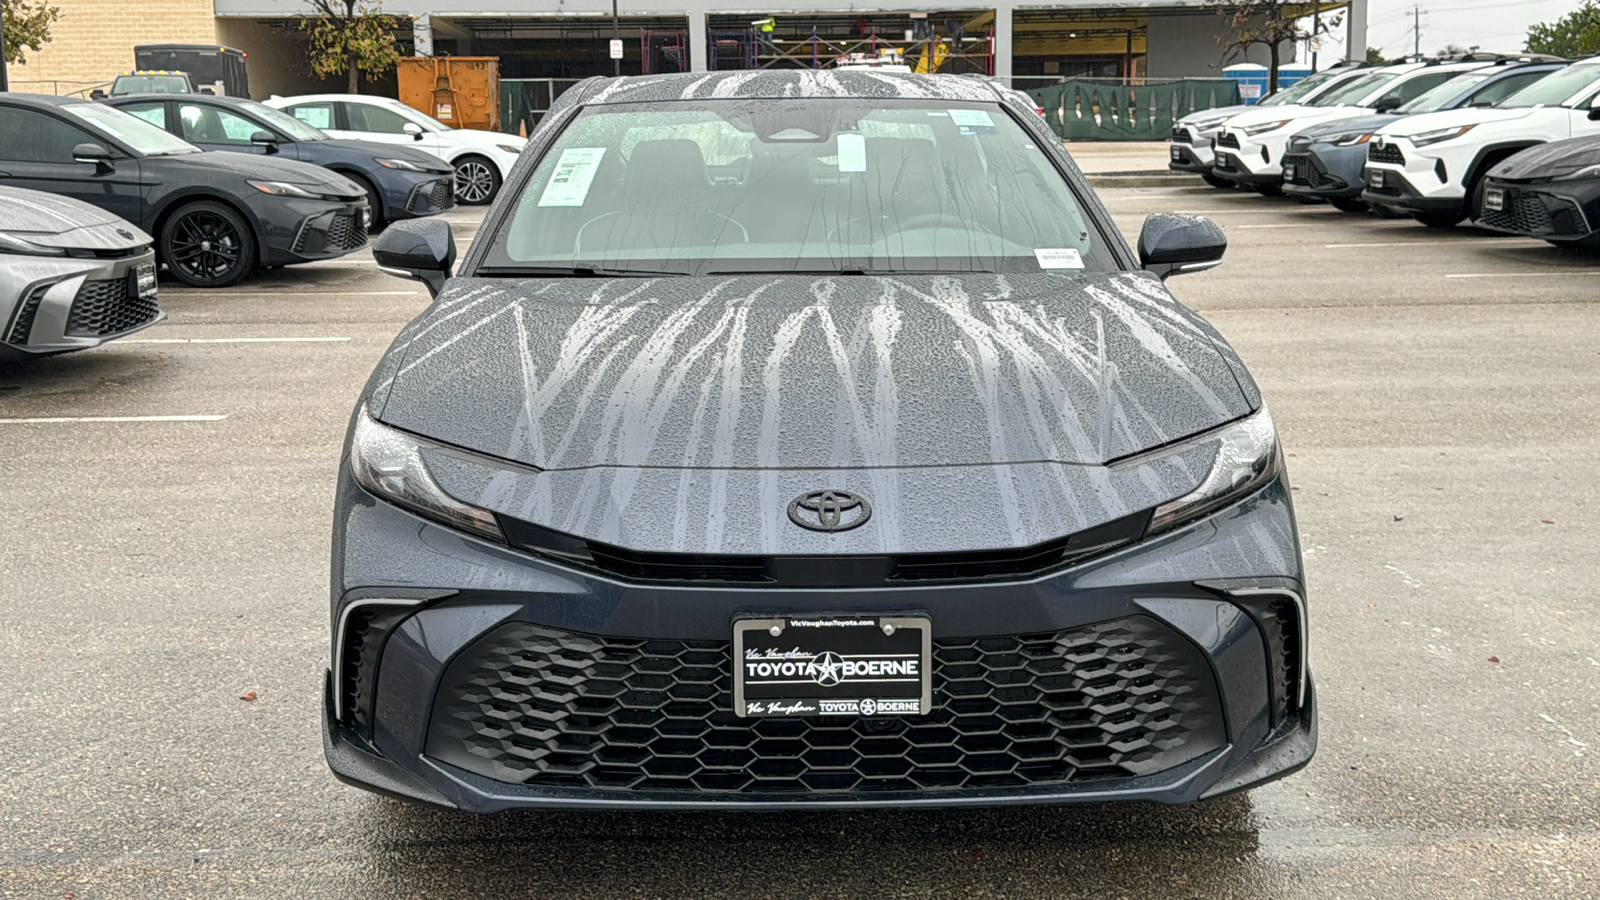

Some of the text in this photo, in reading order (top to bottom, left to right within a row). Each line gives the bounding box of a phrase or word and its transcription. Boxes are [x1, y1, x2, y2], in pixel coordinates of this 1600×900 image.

[790, 619, 875, 628] VicVaughanToyota.com
[744, 646, 813, 660] Vic Vaughan
[746, 662, 818, 676] TOYOTA
[842, 660, 919, 675] BOERNE
[747, 701, 765, 715] Vic
[767, 700, 816, 715] Vaughan
[819, 703, 859, 711] TOYOTA
[877, 702, 919, 711] BOERNE
